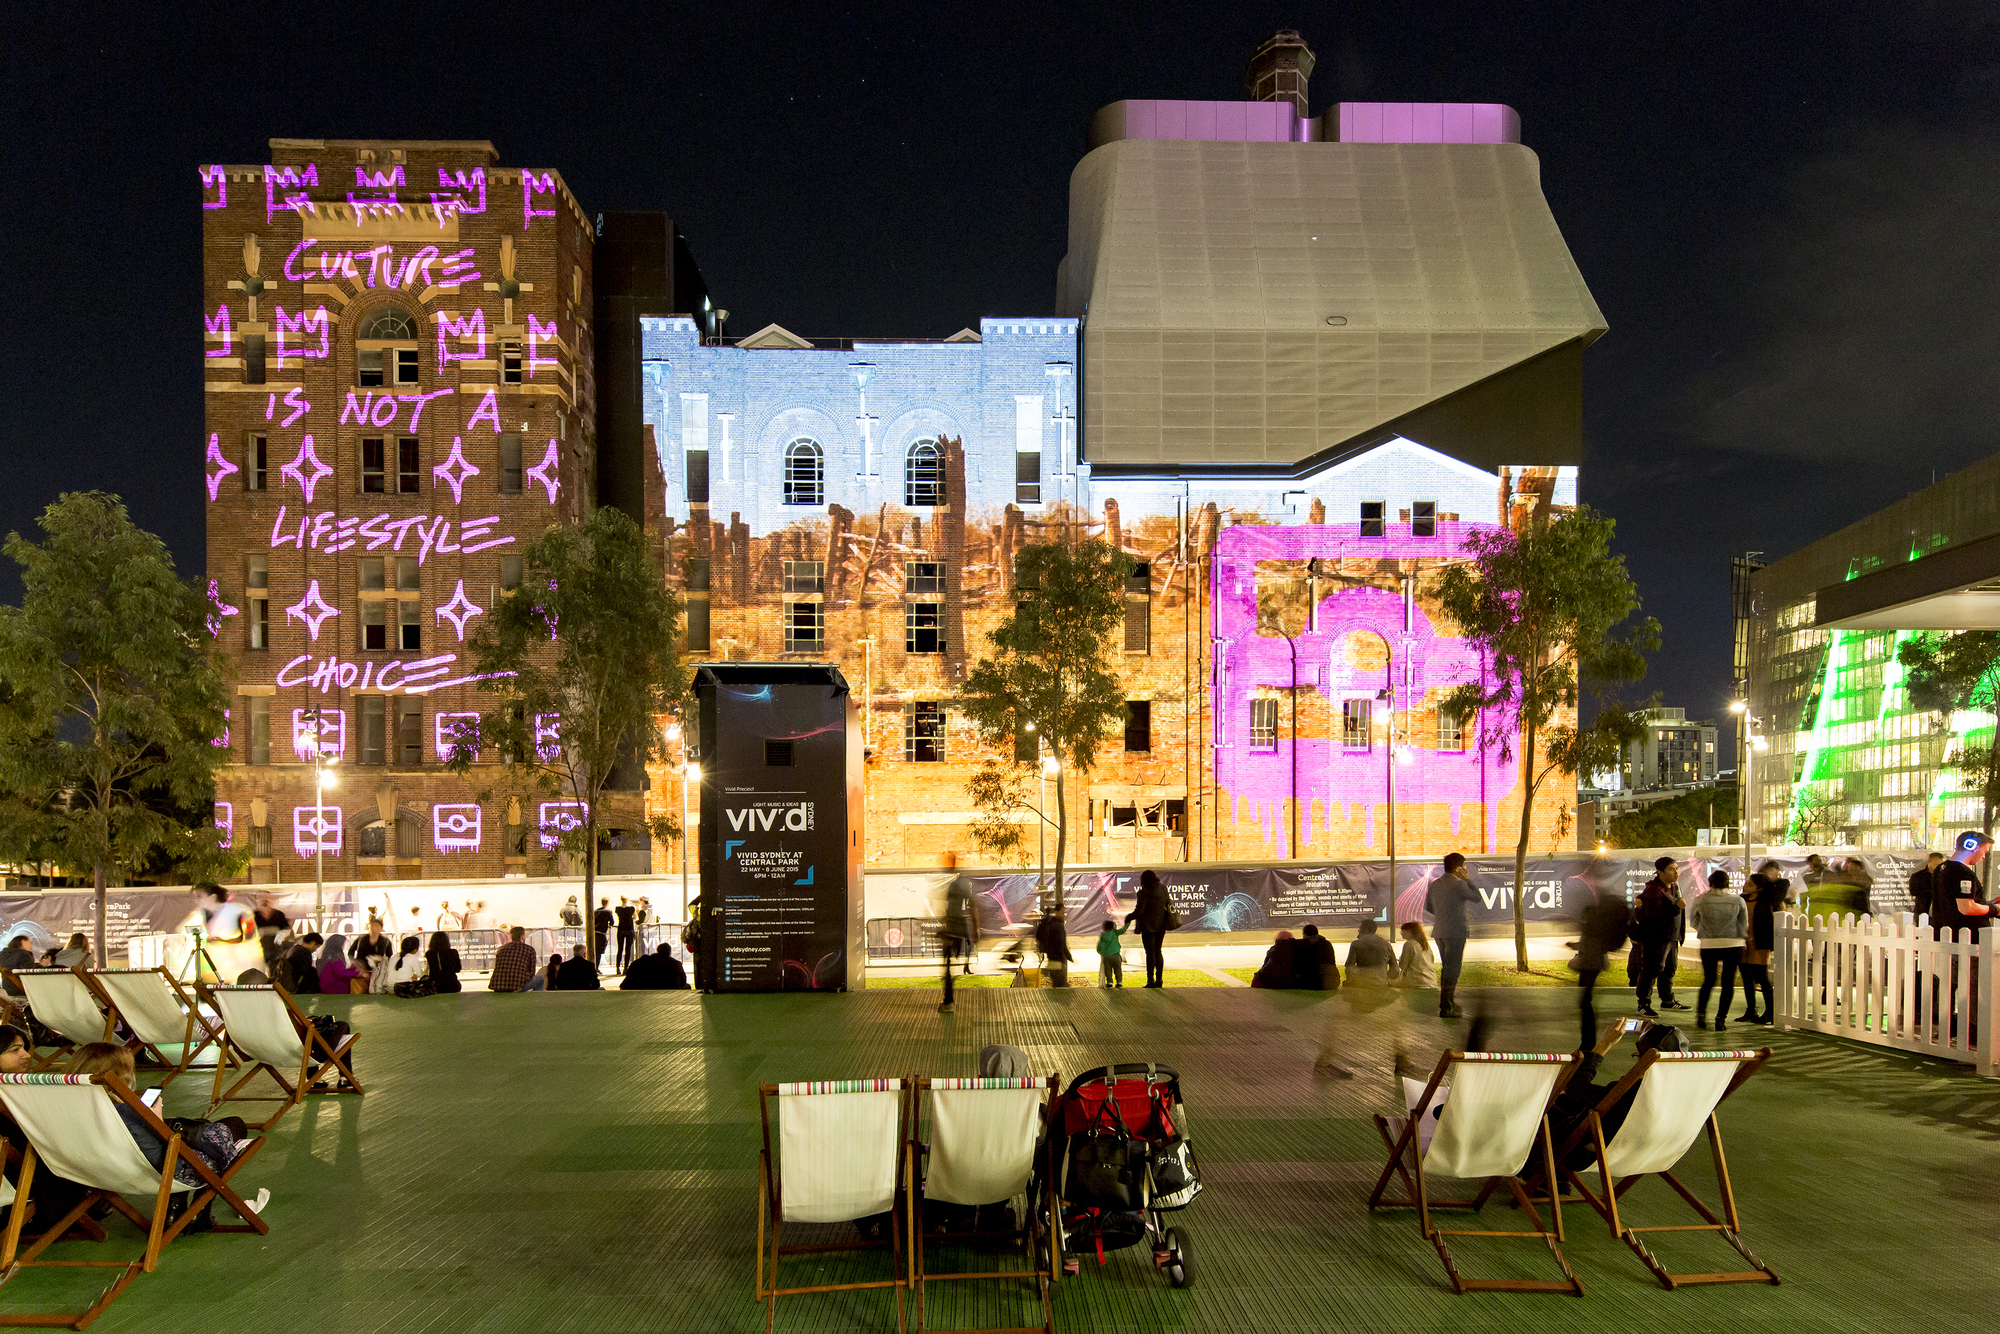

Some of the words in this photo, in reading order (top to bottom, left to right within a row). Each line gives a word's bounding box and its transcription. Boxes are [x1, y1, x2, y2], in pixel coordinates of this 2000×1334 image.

[284, 238, 481, 289] CULTURE
[266, 386, 311, 427] IS
[340, 388, 454, 433] NOT
[467, 388, 502, 434] A
[270, 505, 516, 568] LIFESTYLE
[275, 653, 519, 694] CHOICE
[807, 802, 815, 831] SYDNEY
[760, 851, 792, 859] SYDNEY
[740, 858, 776, 866] CENTRAL
[778, 858, 800, 866] PARK
[1788, 870, 1799, 878] AT
[1166, 884, 1196, 893] YDNEY
[1198, 884, 1209, 892] AT
[1181, 892, 1206, 900] PARK
[106, 910, 122, 918] turing
